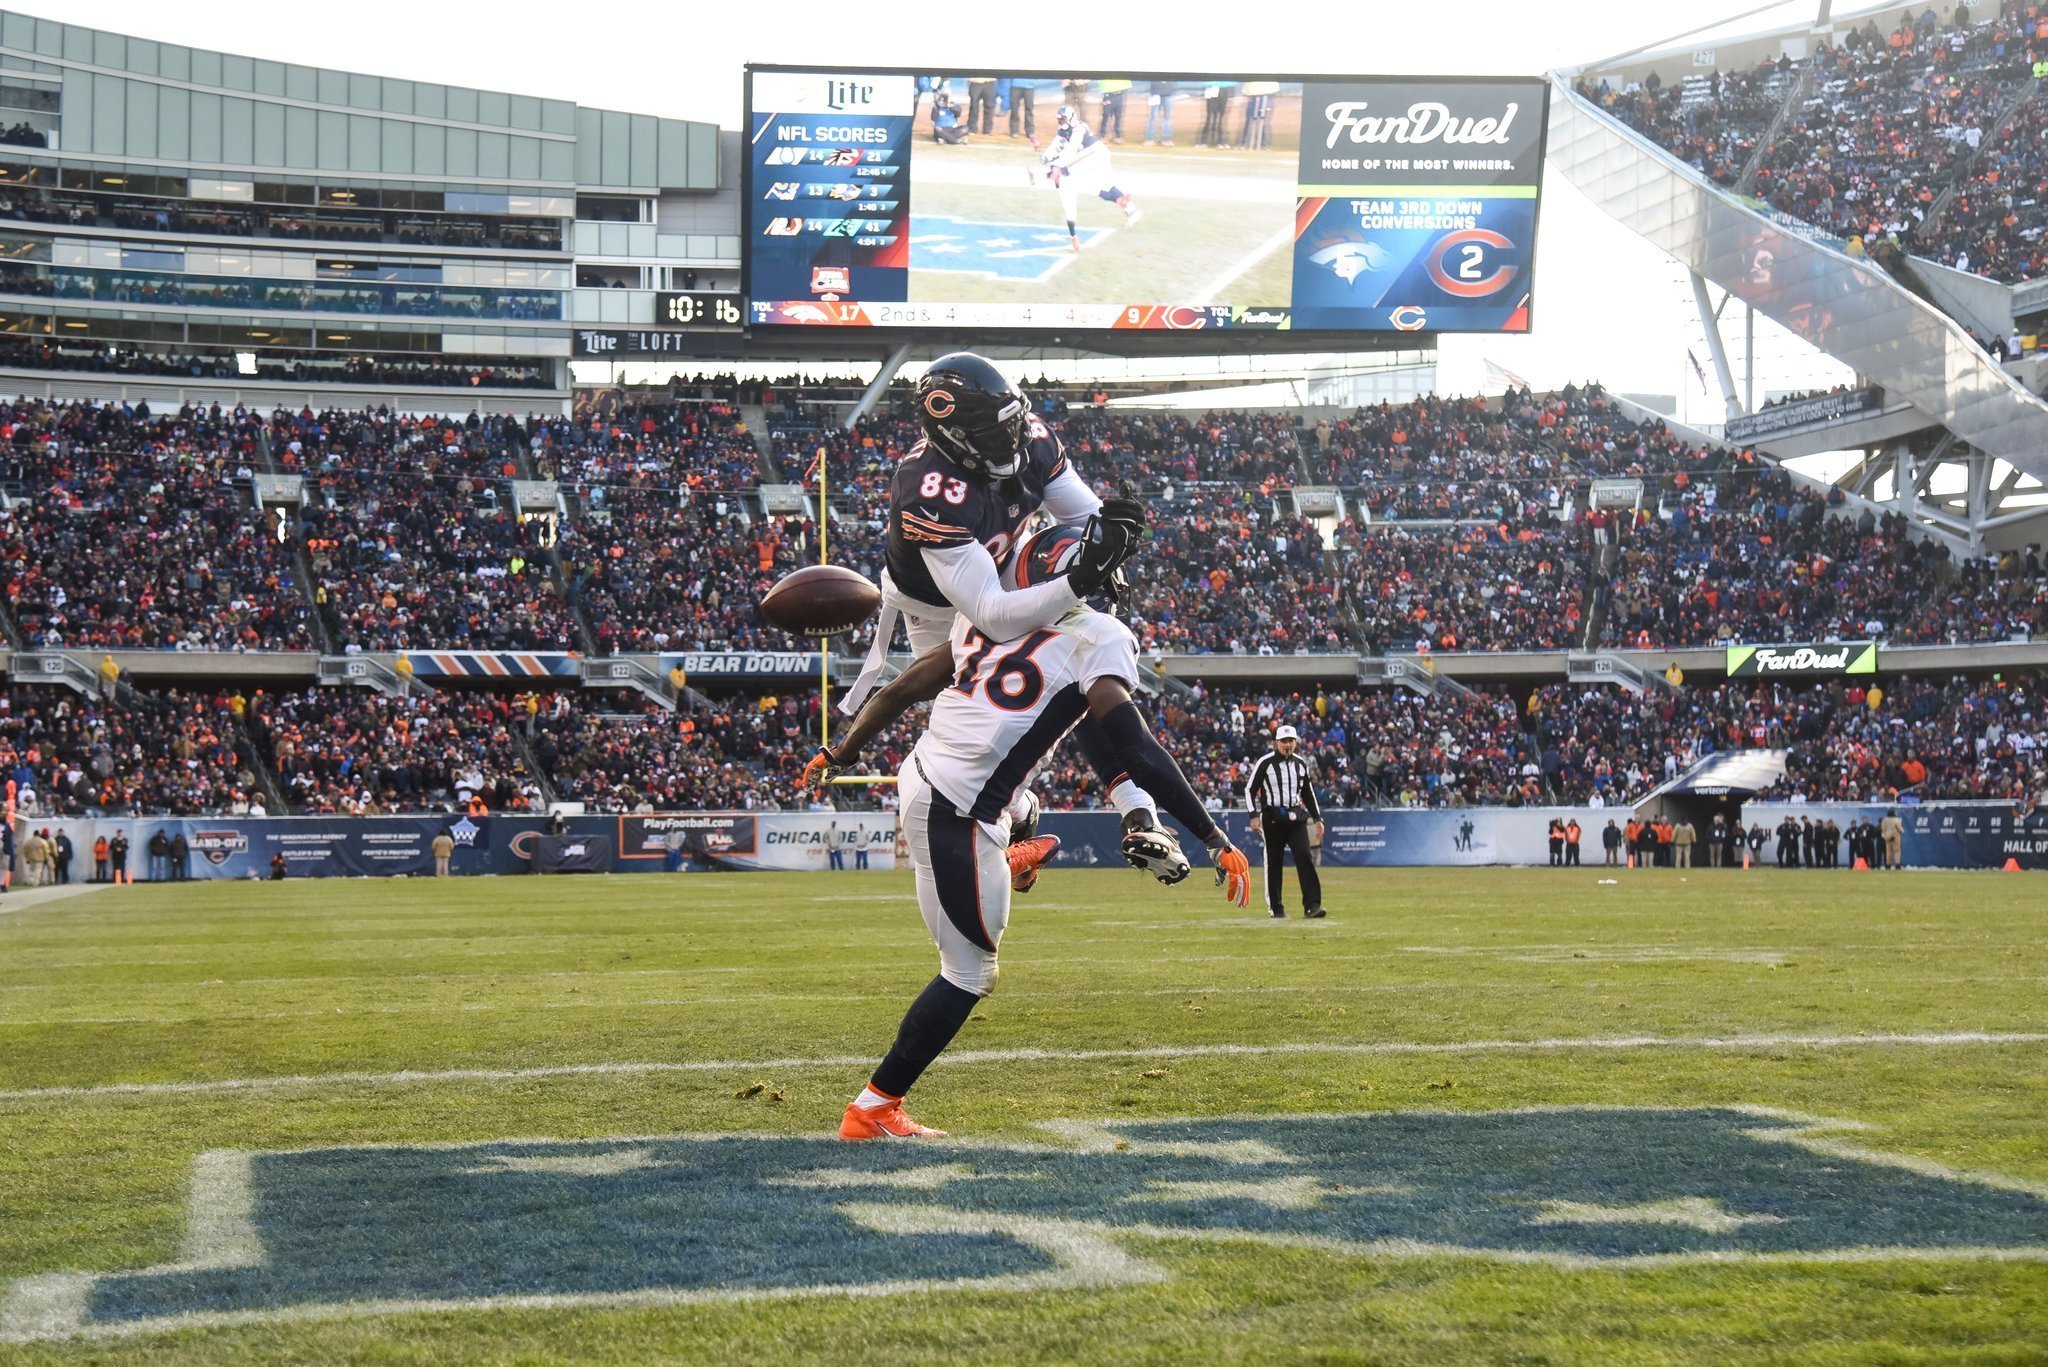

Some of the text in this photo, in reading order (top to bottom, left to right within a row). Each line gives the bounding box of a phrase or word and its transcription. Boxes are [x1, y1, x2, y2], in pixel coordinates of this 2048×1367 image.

[827, 81, 873, 110] Lite
[1325, 101, 1519, 149] FanDuel
[778, 126, 888, 142] NFL SCORES
[809, 151, 882, 161] 14 21
[1322, 159, 1515, 170] HOME OF THE MOST WINNERS.
[808, 186, 878, 197] 13 3
[1350, 201, 1482, 216] TEAM 3RD DOWN
[808, 221, 880, 232] 14 41
[1361, 216, 1476, 230] CONVERSIONS
[1460, 246, 1483, 278] 2
[669, 295, 740, 323] 10:16
[752, 302, 774, 312] TOL
[839, 305, 861, 321] 17
[880, 306, 916, 322] 2nd
[920, 308, 931, 322] &
[946, 307, 955, 322] 4
[1211, 306, 1231, 317] TOL
[758, 313, 767, 322] 2
[1022, 308, 1032, 322] 4
[1128, 308, 1140, 324] 9
[1216, 318, 1224, 327] 3
[579, 331, 617, 354] Lite
[641, 333, 682, 351] LOFT
[920, 471, 969, 505] 83
[684, 656, 811, 673] BEAR DOWN
[1755, 648, 1850, 672] FanDuel
[350, 663, 365, 675] 121
[613, 665, 629, 677] 122
[1388, 664, 1403, 675] 125
[1694, 786, 1728, 795] verizon
[643, 818, 735, 830] PlayFootball.com
[2004, 840, 2033, 853] HALL
